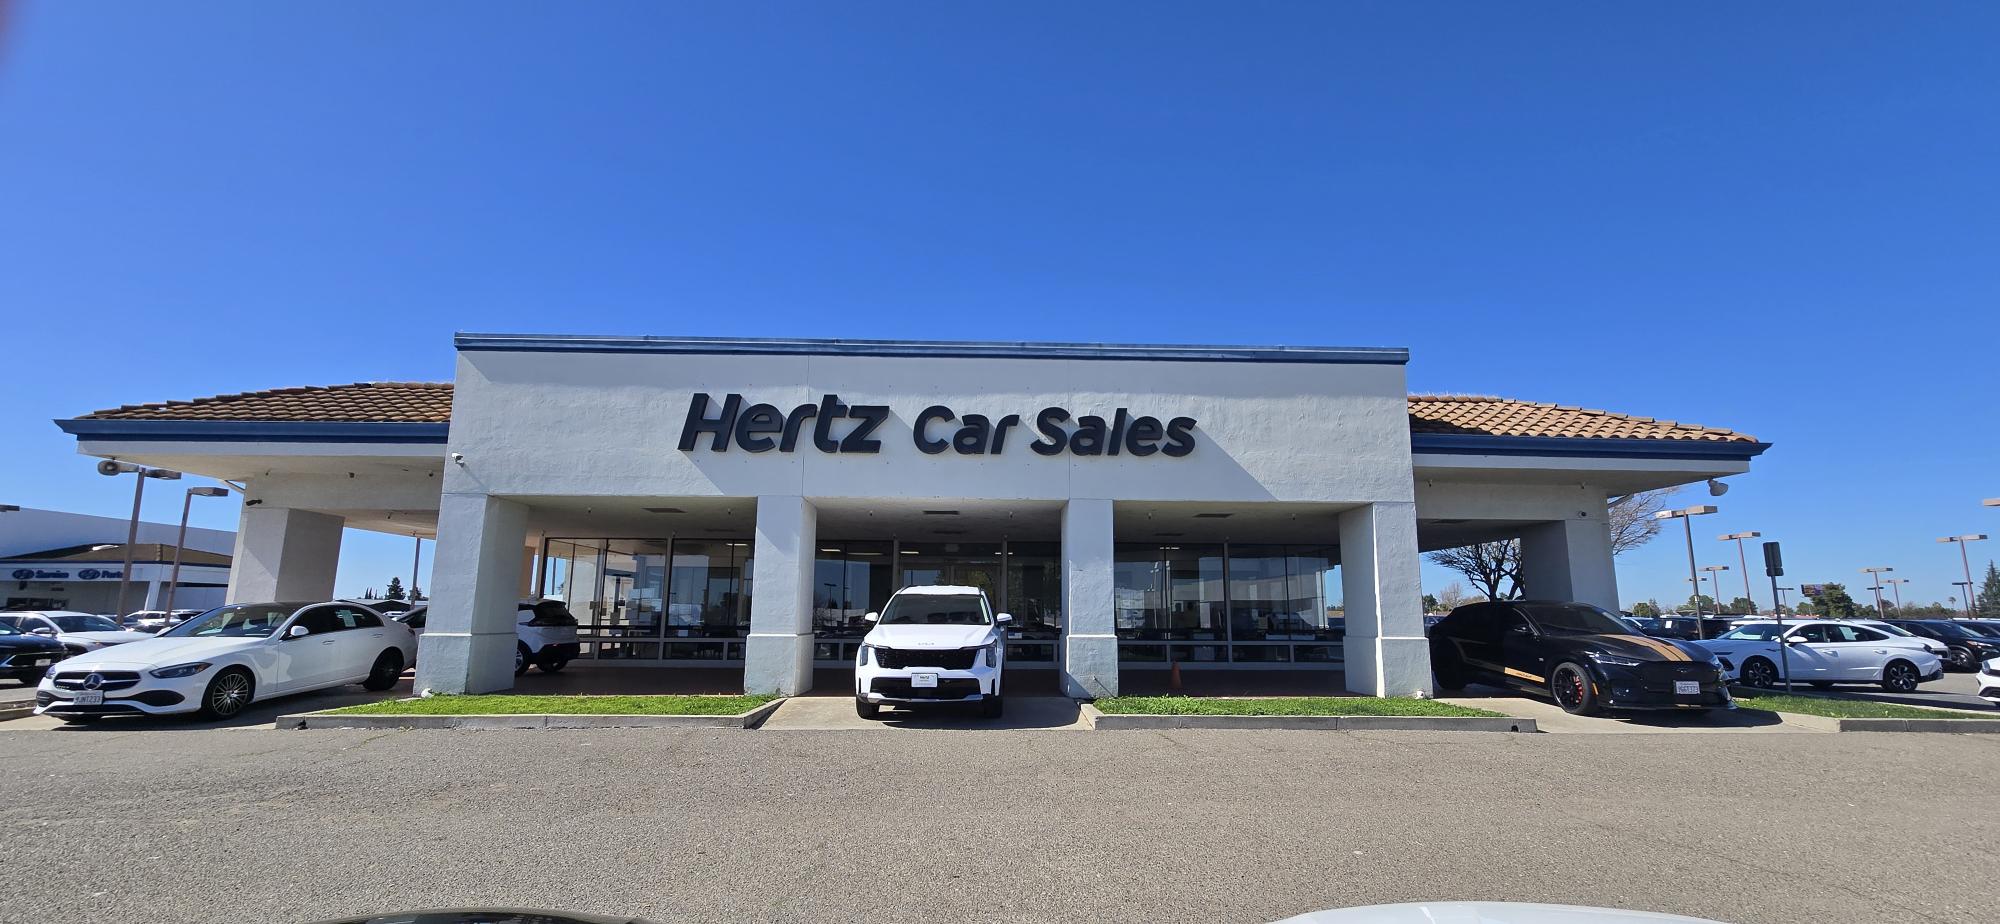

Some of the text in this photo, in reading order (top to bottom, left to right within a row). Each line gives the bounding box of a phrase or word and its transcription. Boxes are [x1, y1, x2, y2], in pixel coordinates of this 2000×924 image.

[677, 393, 1197, 457] Hertz Car Sales
